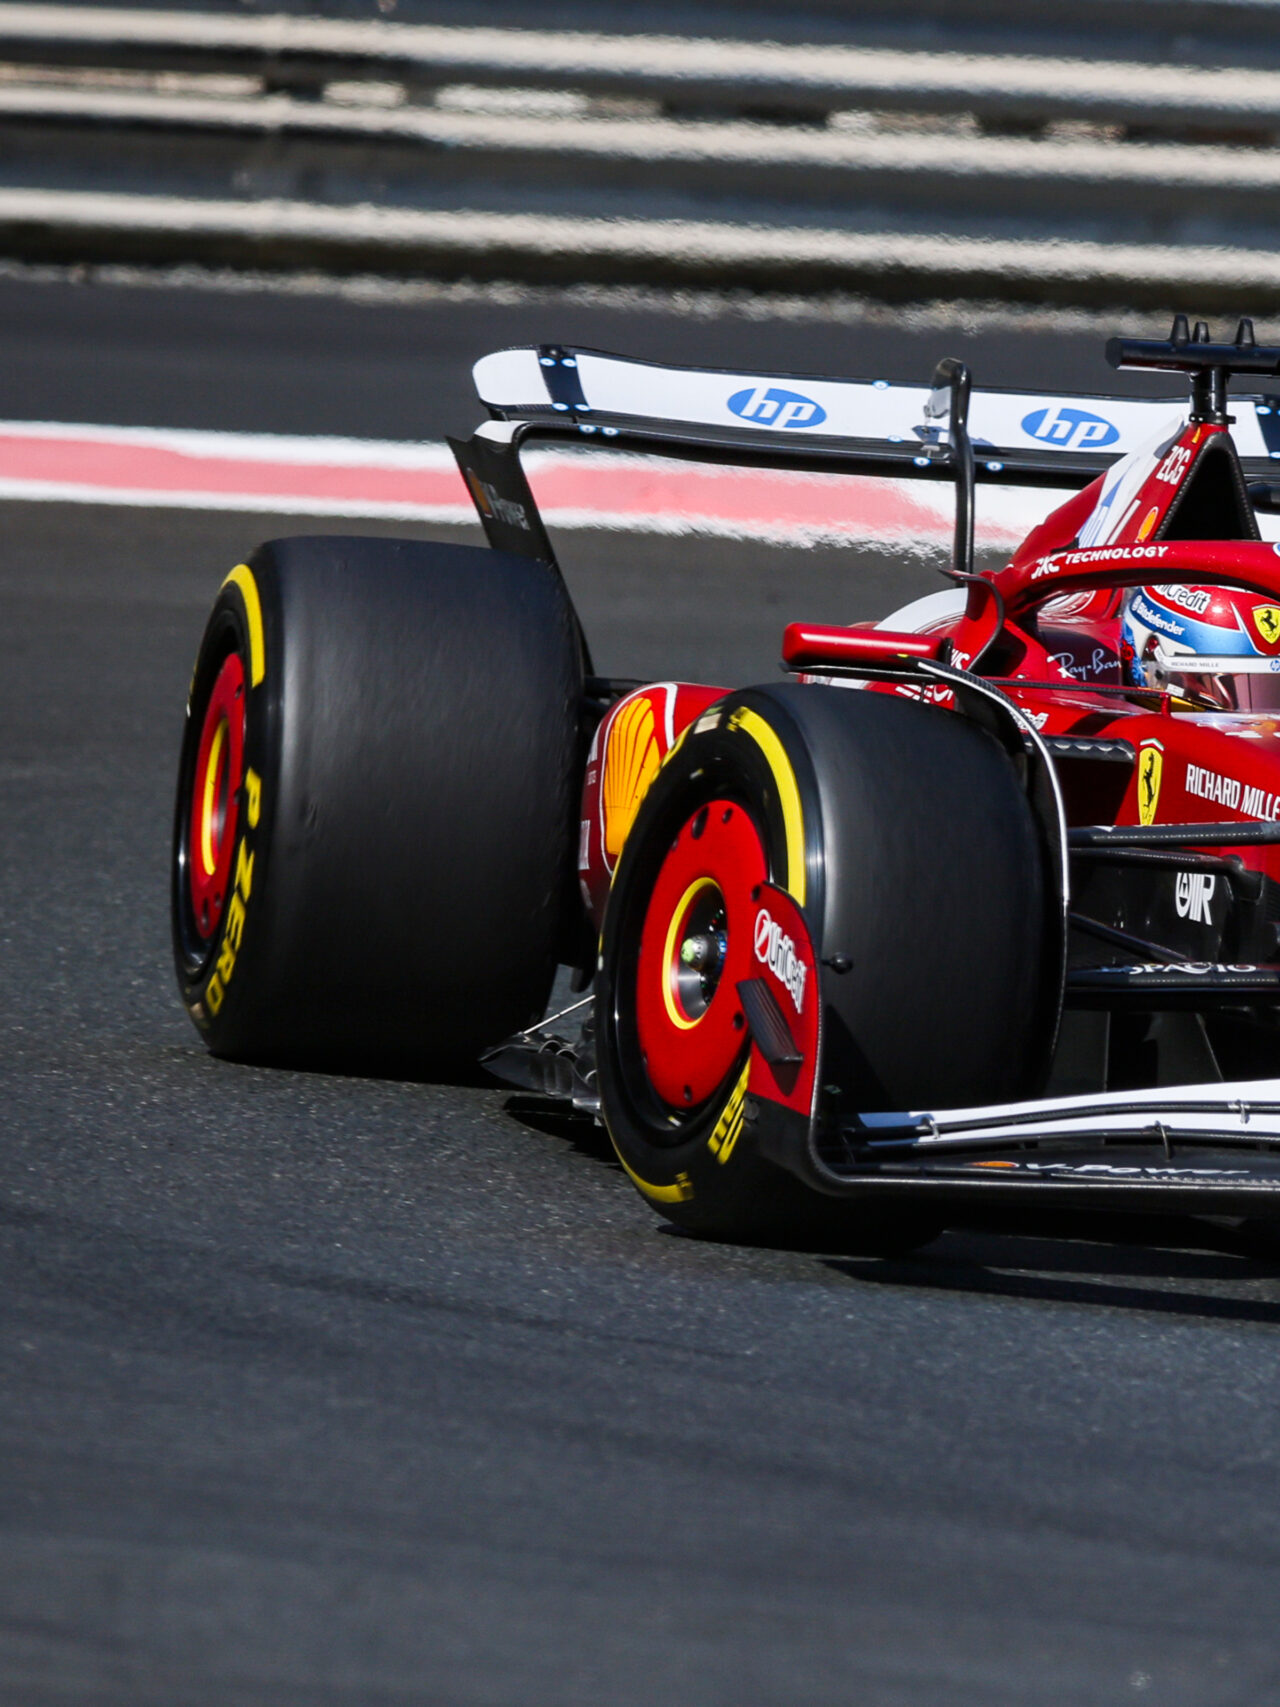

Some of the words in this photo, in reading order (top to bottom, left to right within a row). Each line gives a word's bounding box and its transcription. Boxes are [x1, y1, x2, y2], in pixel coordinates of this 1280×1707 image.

[739, 385, 818, 428] hp
[1033, 406, 1111, 448] hp
[1065, 546, 1168, 565] TECHNOLOGY
[1047, 648, 1122, 681] Ray-Ban
[1185, 763, 1241, 810] RICHARD
